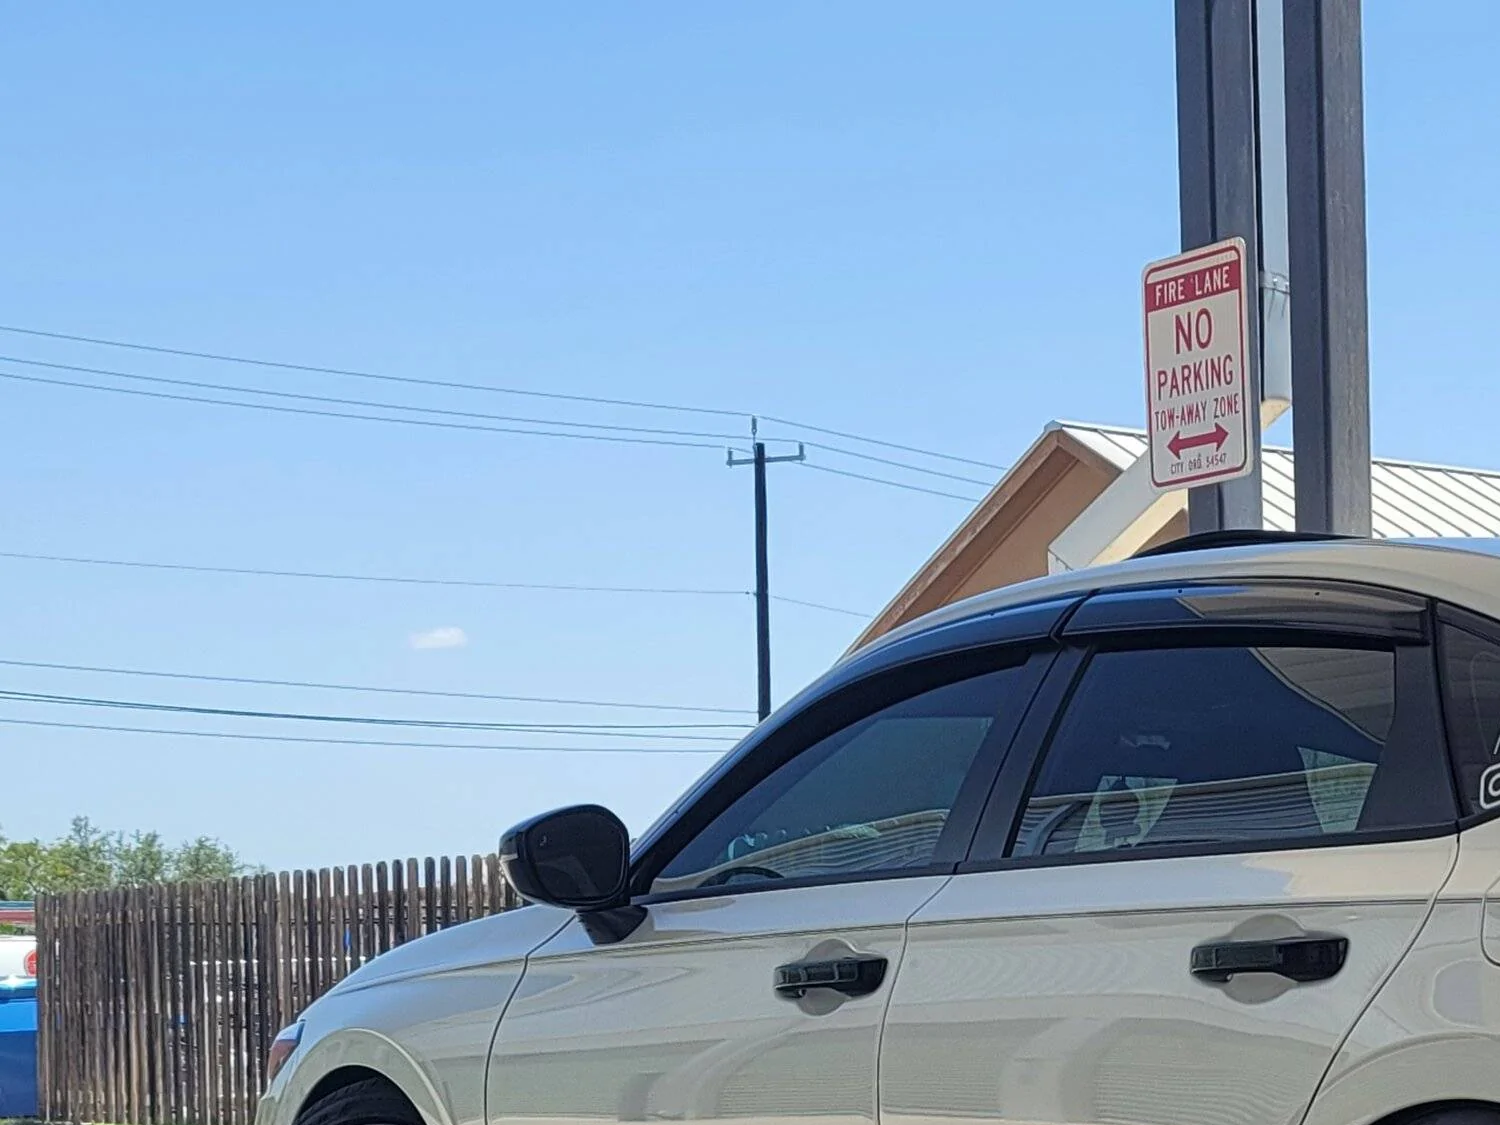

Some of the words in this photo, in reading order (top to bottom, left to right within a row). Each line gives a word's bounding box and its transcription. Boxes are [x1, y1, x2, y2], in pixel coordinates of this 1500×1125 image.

[1155, 278, 1186, 307] FIRE
[1194, 265, 1230, 297] LANE
[1174, 307, 1213, 355] NO
[1157, 353, 1234, 401] PARKING
[1154, 400, 1207, 433] TOW-AWAY
[1214, 392, 1240, 419] ZONE
